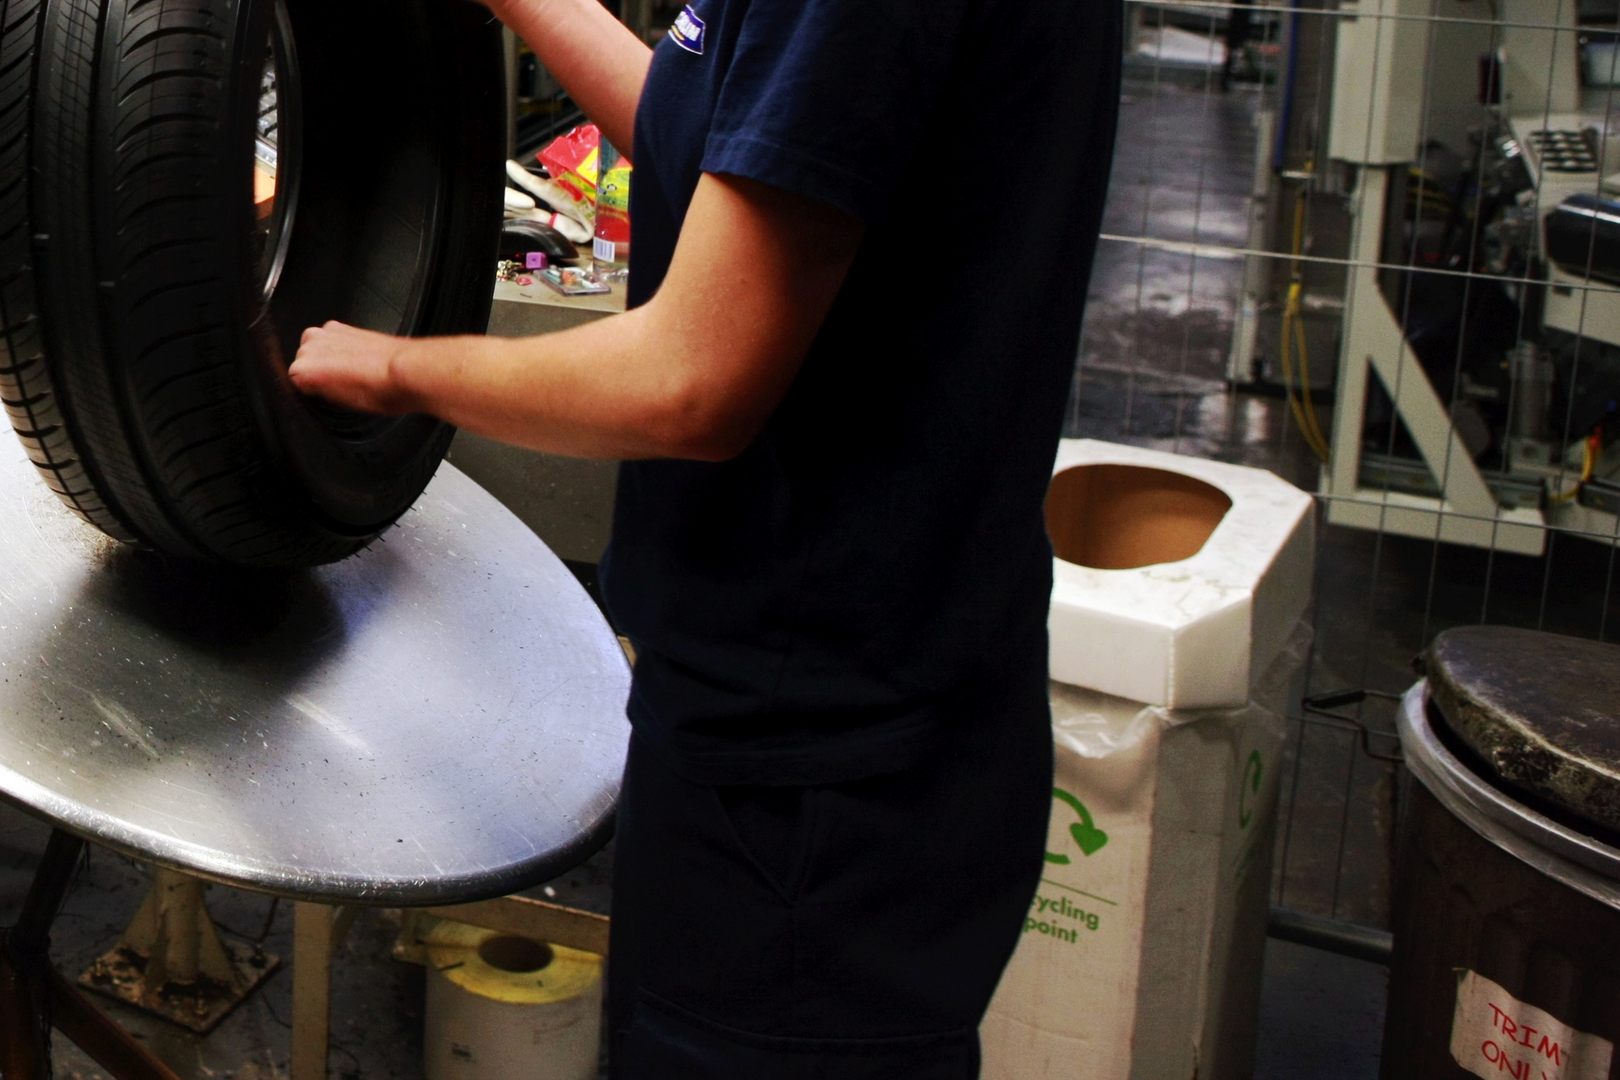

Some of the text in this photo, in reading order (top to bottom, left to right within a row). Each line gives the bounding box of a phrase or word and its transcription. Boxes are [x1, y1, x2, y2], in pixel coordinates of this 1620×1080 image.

[1022, 916, 1079, 944] point
[1030, 894, 1099, 931] ycling
[1488, 1002, 1560, 1067] TRIM
